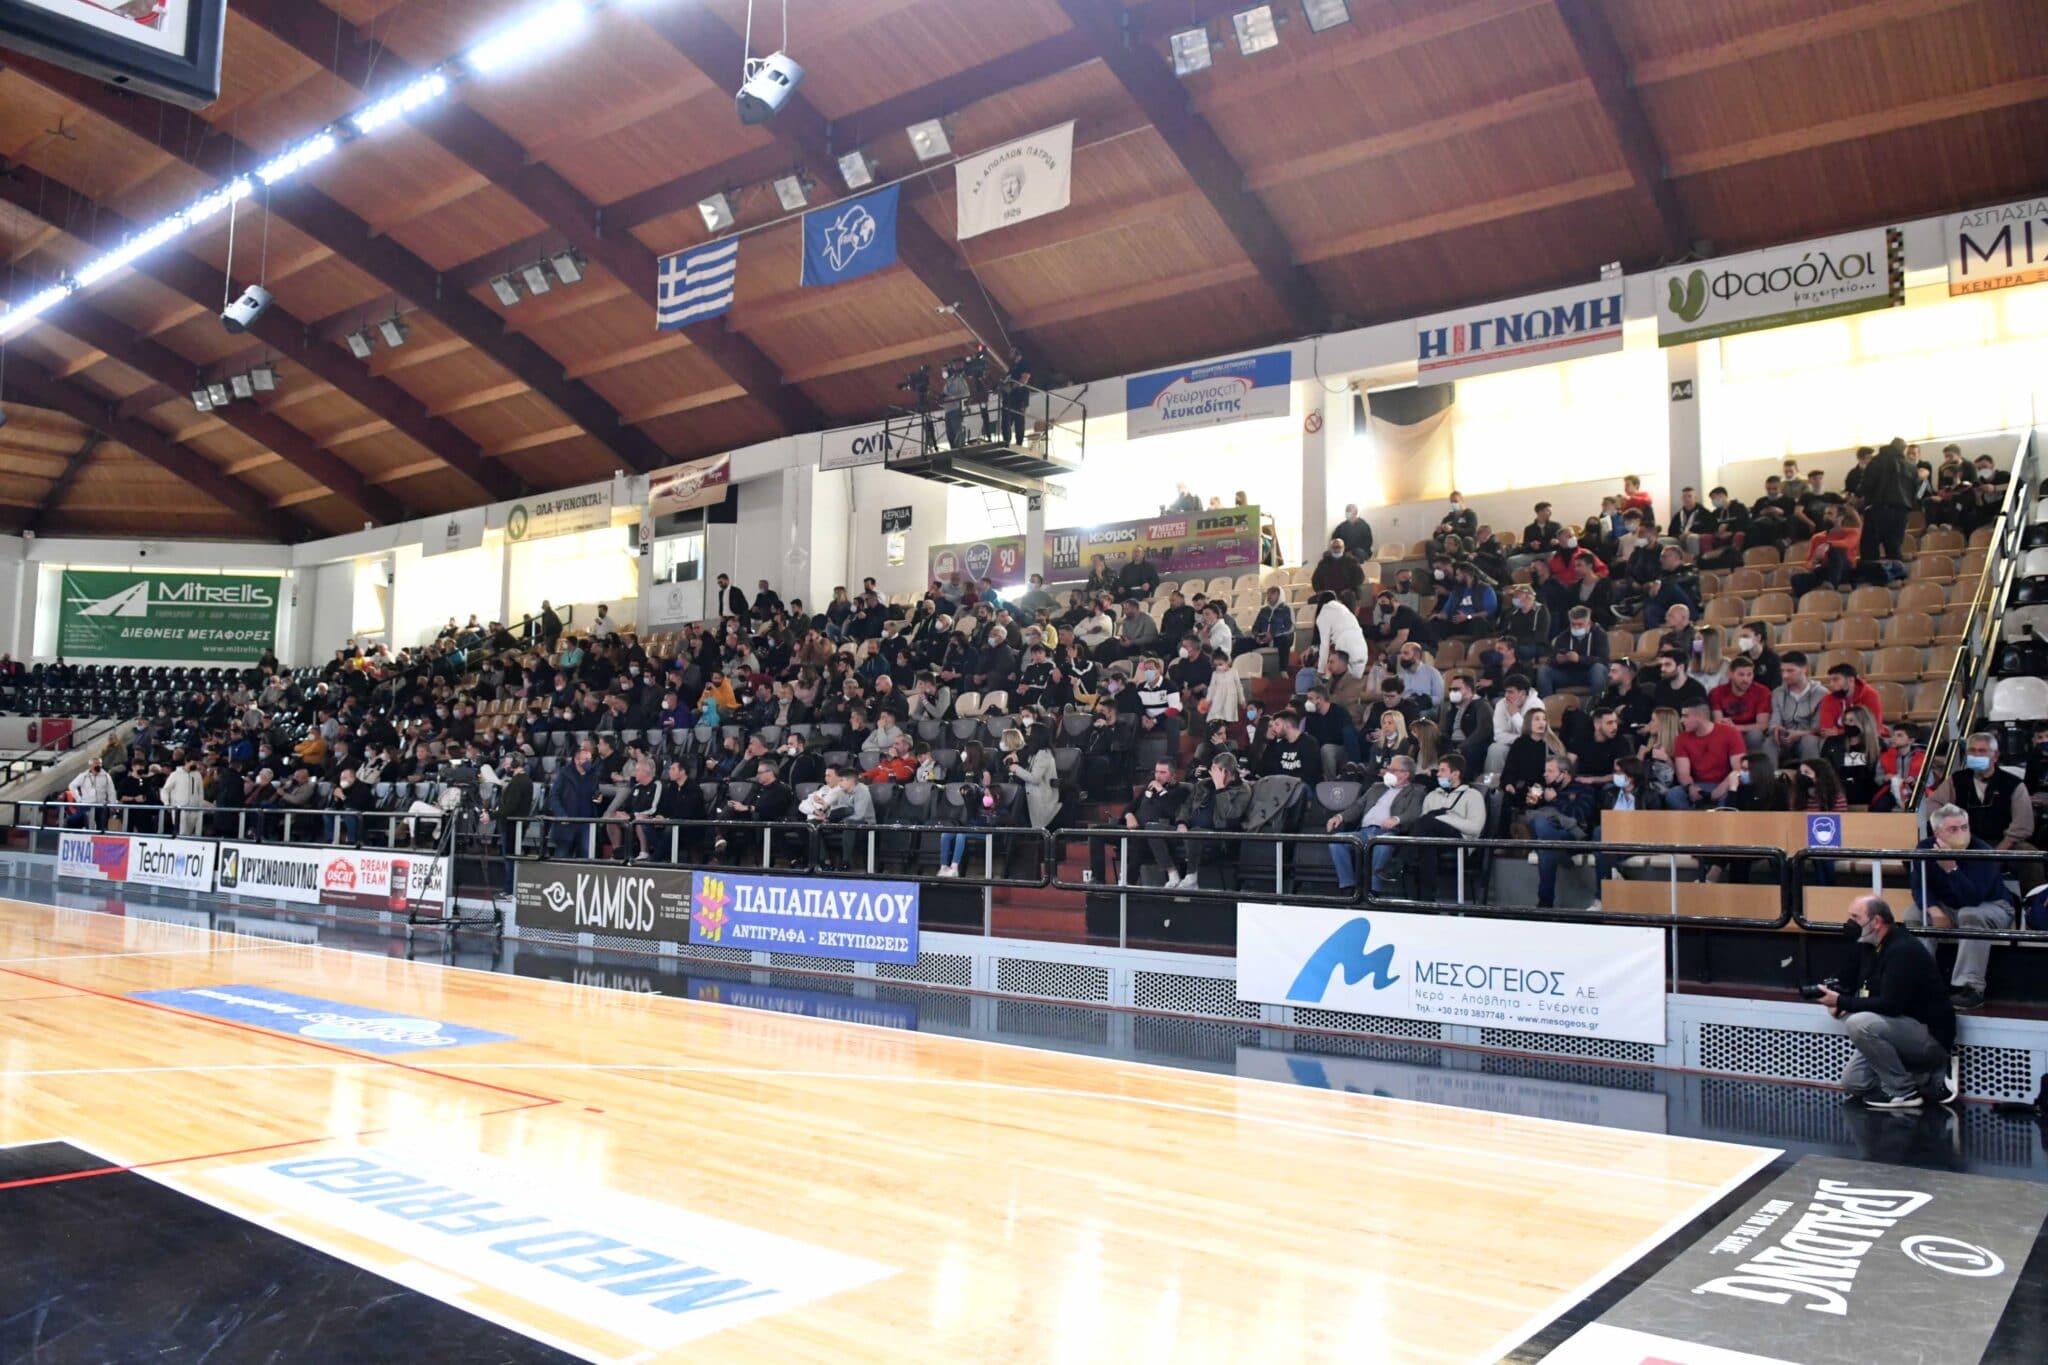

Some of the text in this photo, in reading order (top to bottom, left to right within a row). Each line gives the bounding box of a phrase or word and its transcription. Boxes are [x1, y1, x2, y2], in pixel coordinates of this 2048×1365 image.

[1712, 250, 1876, 301] Φασόλοι
[1961, 275, 2023, 293] ΚΕΝΤΡΑ
[1418, 327, 1448, 359] Η
[1469, 294, 1622, 352] ΓΝΩΜΗ
[1162, 397, 1241, 421] λευκαδίτης
[1053, 534, 1079, 554] LUX
[120, 627, 186, 639] ΔΙΕΘΝΕΙΣ
[187, 628, 271, 641] ΜΕΤΑΦΟΡΕΣ
[240, 856, 319, 891] ΧΡΥΣΑΝΘΟΠΟΥΛΟΣ
[360, 858, 389, 872] DREAM
[361, 871, 387, 886] TEAM
[575, 873, 656, 932] KAMISIS
[734, 885, 914, 924] ΠΑΠΑΠΑΥΛΟΥ
[732, 924, 806, 944] ΑΝΤΙΓΡΑΦΑ
[818, 931, 909, 953] ΕΚΤΥΠΩΣΕΙΣ
[1415, 961, 1565, 996] ΜΕΣΟΓΕΙΟΣ
[1415, 989, 1445, 1003] Νερό
[1539, 1000, 1599, 1017] Ενέργεια
[1517, 1015, 1599, 1031] www.mesogeos.gr
[266, 1156, 781, 1316] MED FRIGO
[1700, 1179, 1933, 1316] SPALDING
